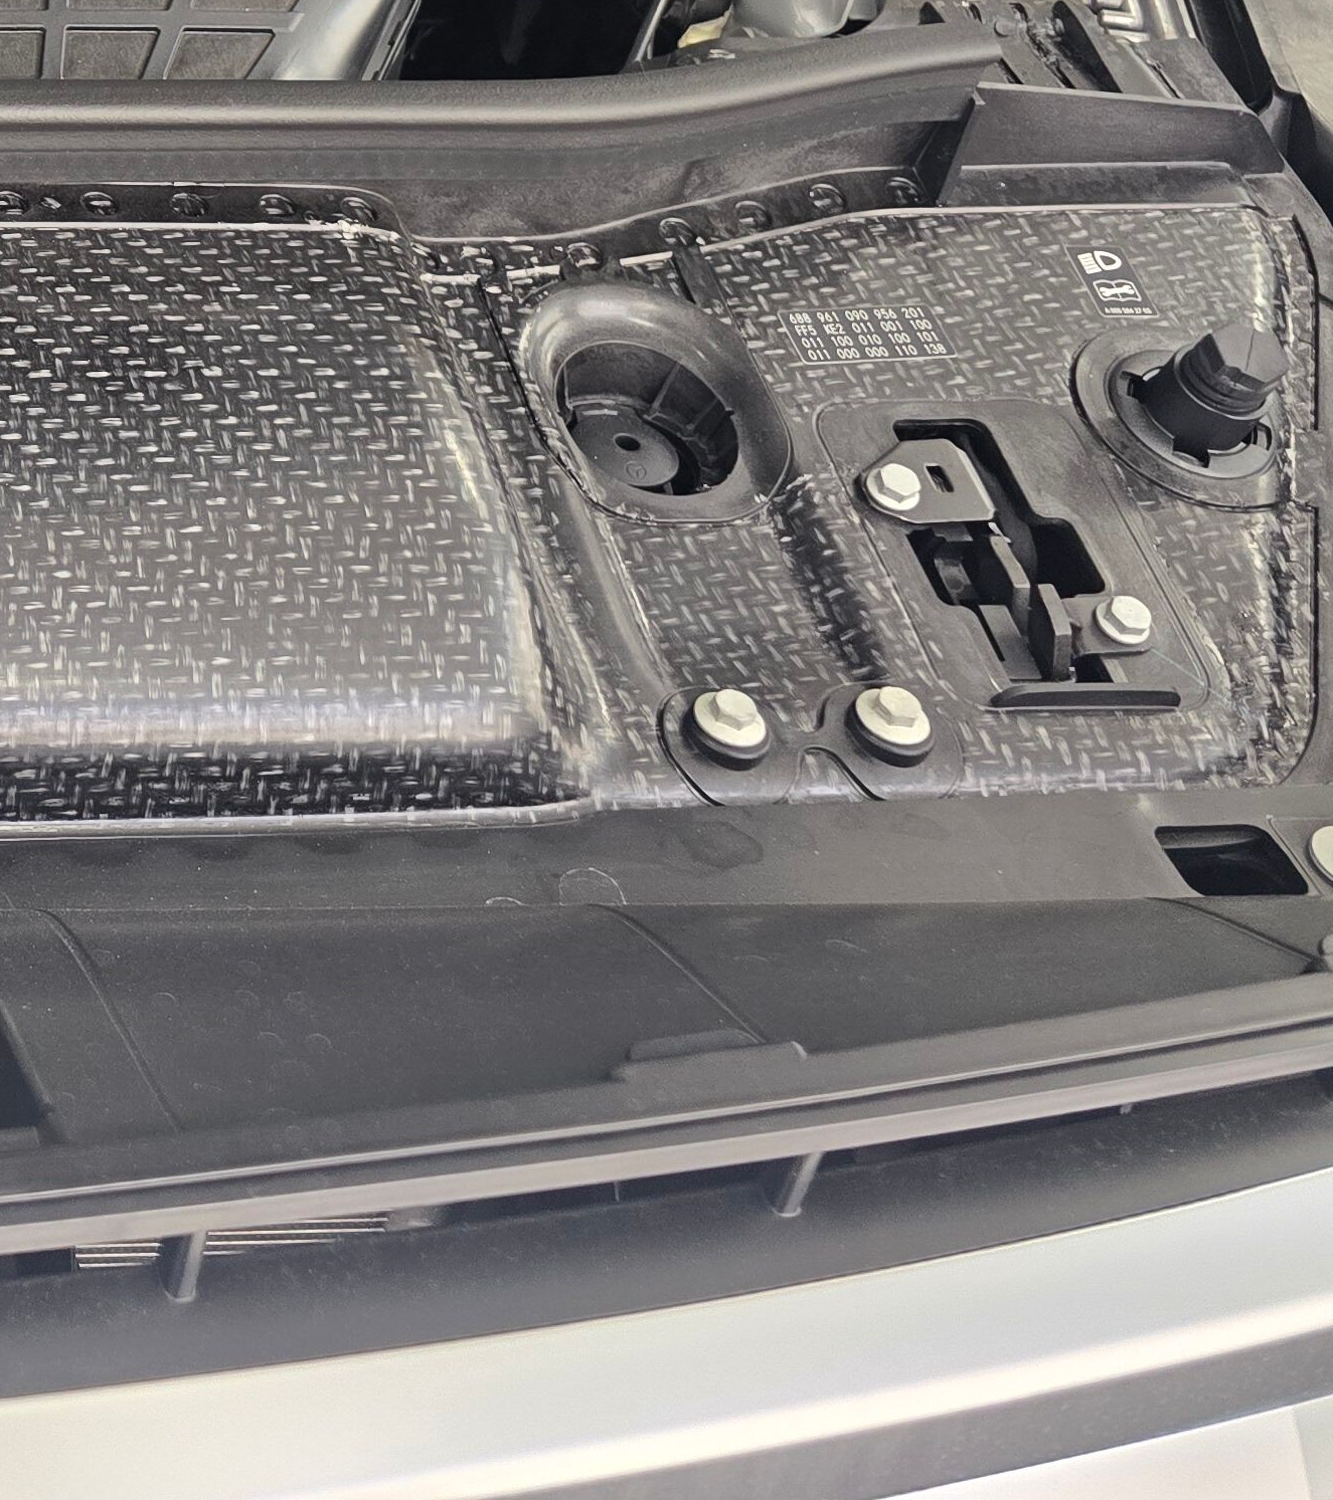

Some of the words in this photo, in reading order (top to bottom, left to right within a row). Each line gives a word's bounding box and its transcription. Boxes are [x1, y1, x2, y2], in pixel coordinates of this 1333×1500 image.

[817, 311, 839, 323] 961
[845, 310, 869, 321] 090
[873, 308, 897, 320] 956
[901, 307, 925, 318] 201
[794, 325, 817, 336] FF5
[823, 323, 846, 335] KE2
[852, 322, 875, 334] 011
[880, 320, 903, 332] 001
[910, 319, 932, 330] 100
[802, 337, 824, 348] 011
[831, 336, 853, 347] 100
[858, 334, 882, 346] 010
[888, 333, 911, 344] 100
[917, 331, 939, 342] 101
[808, 349, 830, 360] 011
[836, 348, 860, 360] 000
[865, 346, 889, 358] 000
[895, 345, 918, 356] 110
